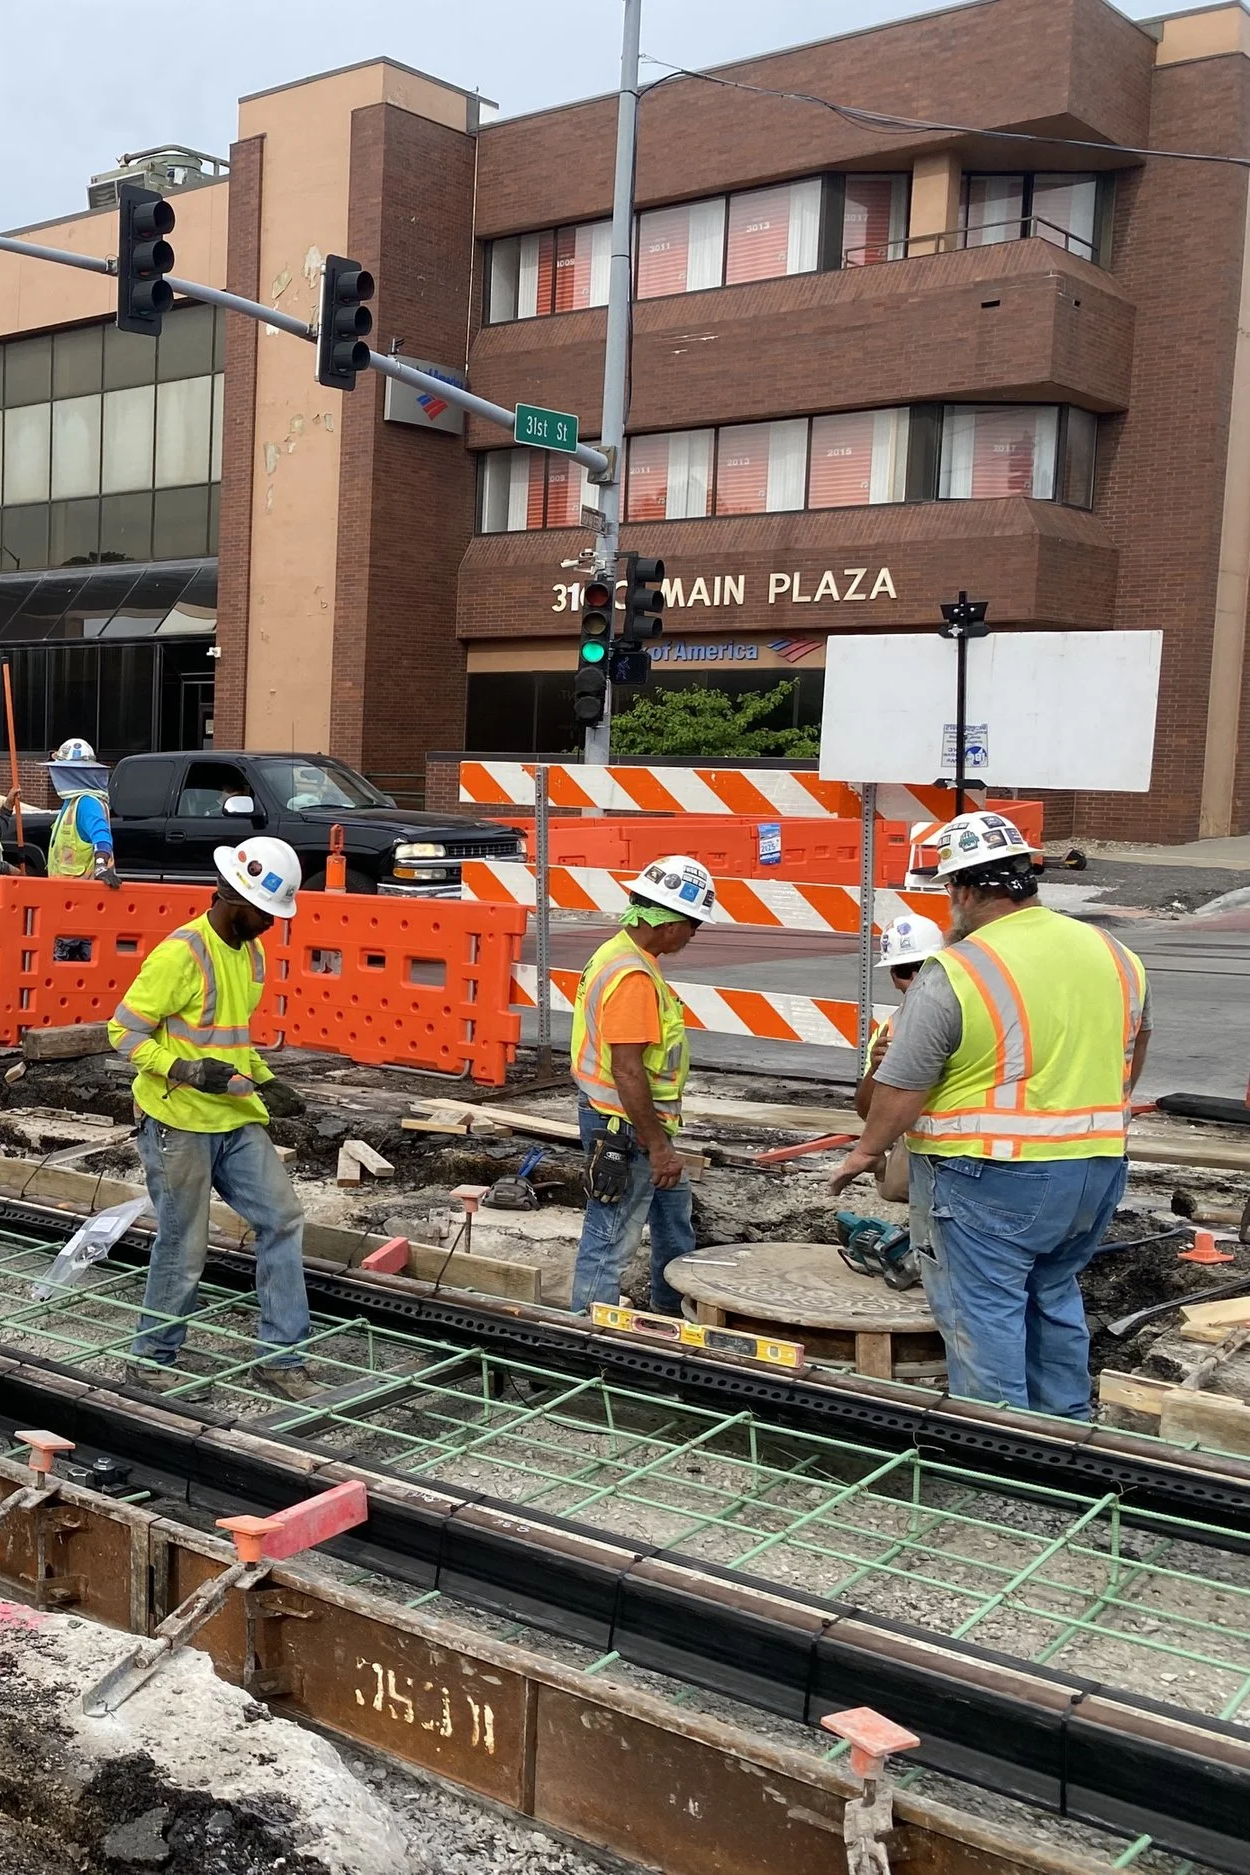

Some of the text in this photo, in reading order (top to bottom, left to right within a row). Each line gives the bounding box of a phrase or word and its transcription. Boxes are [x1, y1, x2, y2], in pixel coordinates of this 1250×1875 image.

[745, 221, 770, 233] 3013
[649, 242, 670, 253] 3011
[526, 415, 568, 442] 31st St
[826, 447, 852, 457] 2015
[726, 457, 750, 467] 2013
[630, 467, 651, 476] 2011
[551, 567, 898, 613] 31 MAIN PLAZA
[649, 639, 758, 661] of America
